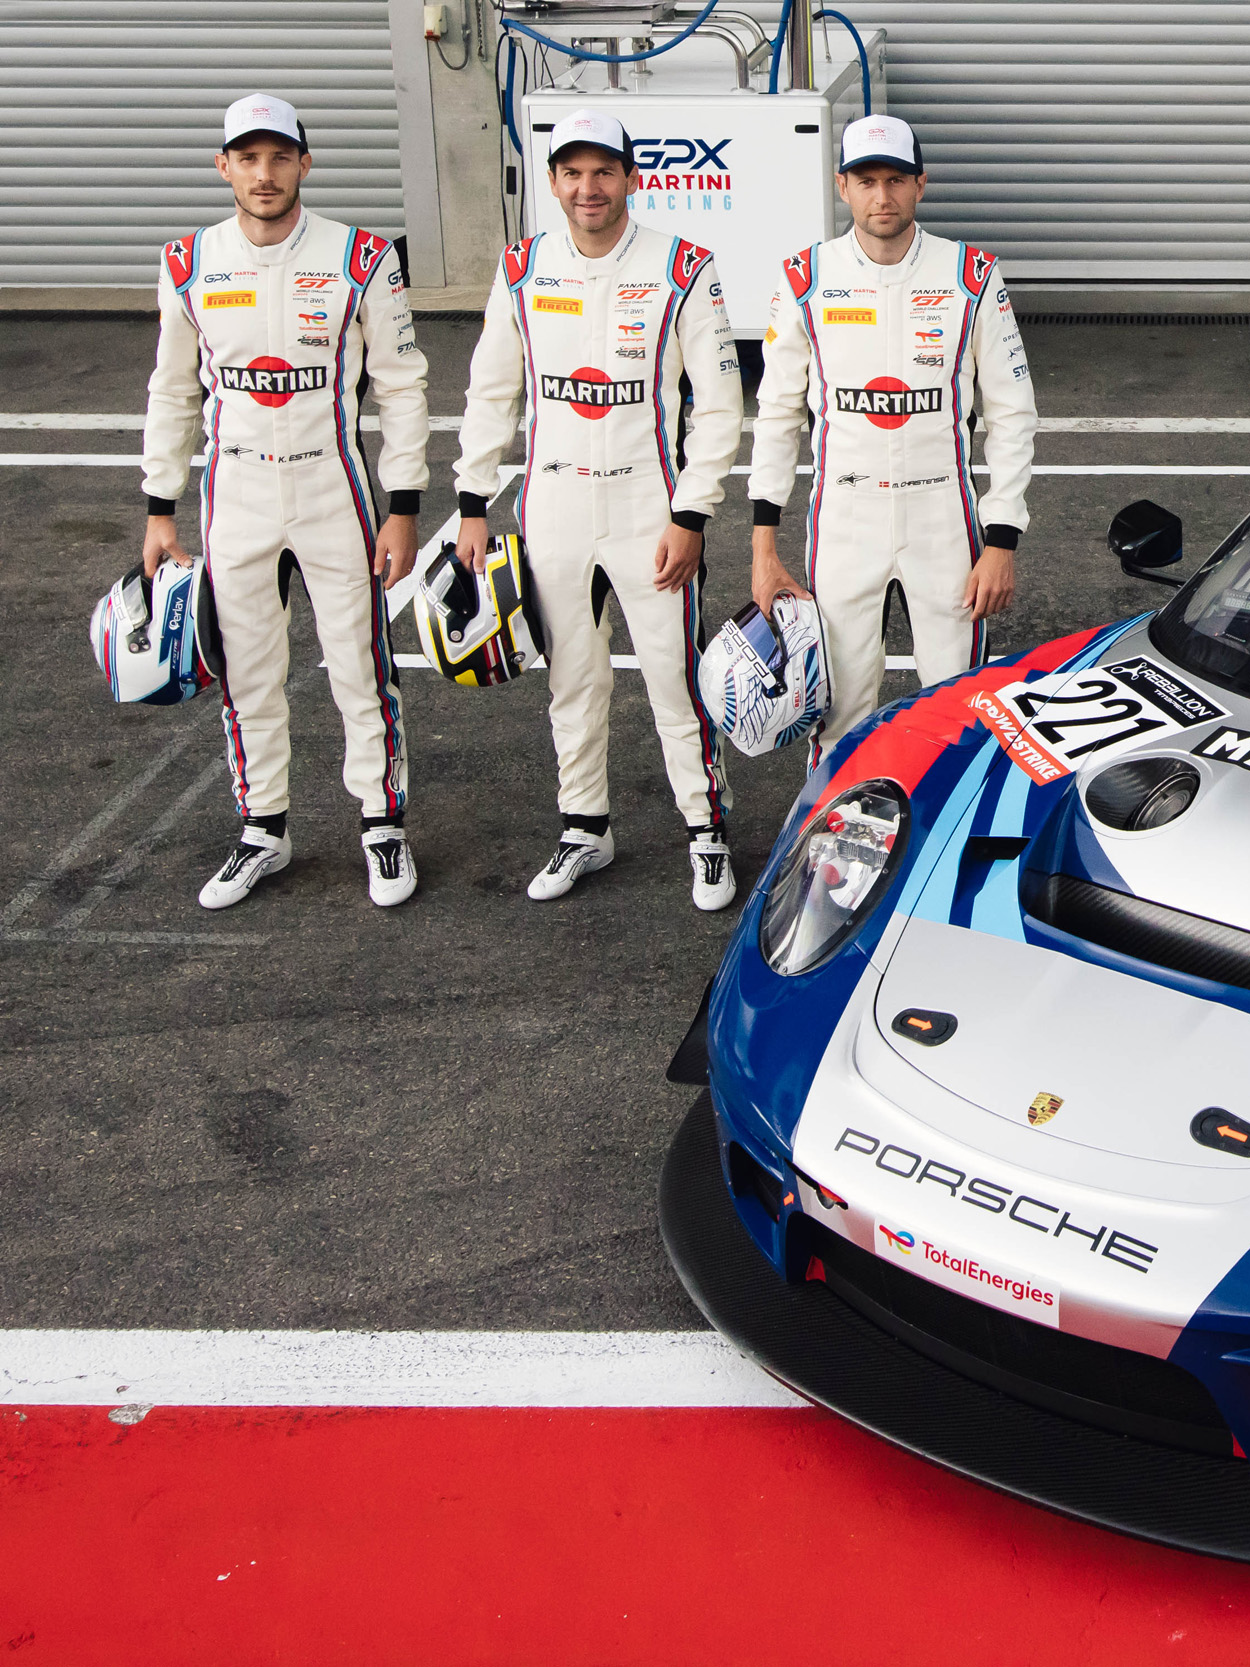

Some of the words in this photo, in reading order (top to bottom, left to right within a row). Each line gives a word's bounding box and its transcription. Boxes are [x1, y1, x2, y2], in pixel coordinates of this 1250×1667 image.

[631, 138, 733, 170] GPX
[204, 272, 234, 284] GPX
[294, 271, 340, 279] FANATEC
[535, 277, 562, 288] GPX
[207, 292, 253, 306] PIRELLI
[822, 289, 851, 298] GPX
[309, 297, 326, 305] aws
[536, 298, 580, 313] PIRELLI
[827, 310, 873, 322] PIRELLI
[926, 314, 942, 322] aws
[221, 366, 326, 393] MARTINI
[542, 376, 643, 404] MARTINI
[837, 388, 942, 414] MARTINI
[288, 448, 324, 462] ESTRE
[603, 466, 633, 477] LIETZ
[1139, 668, 1212, 717] REBELLION
[1011, 680, 1168, 761] 221
[976, 696, 1062, 781] CROWDSTRIKE
[833, 1127, 1160, 1274] PORSCHE
[921, 1240, 1054, 1308] TotalEnergies
